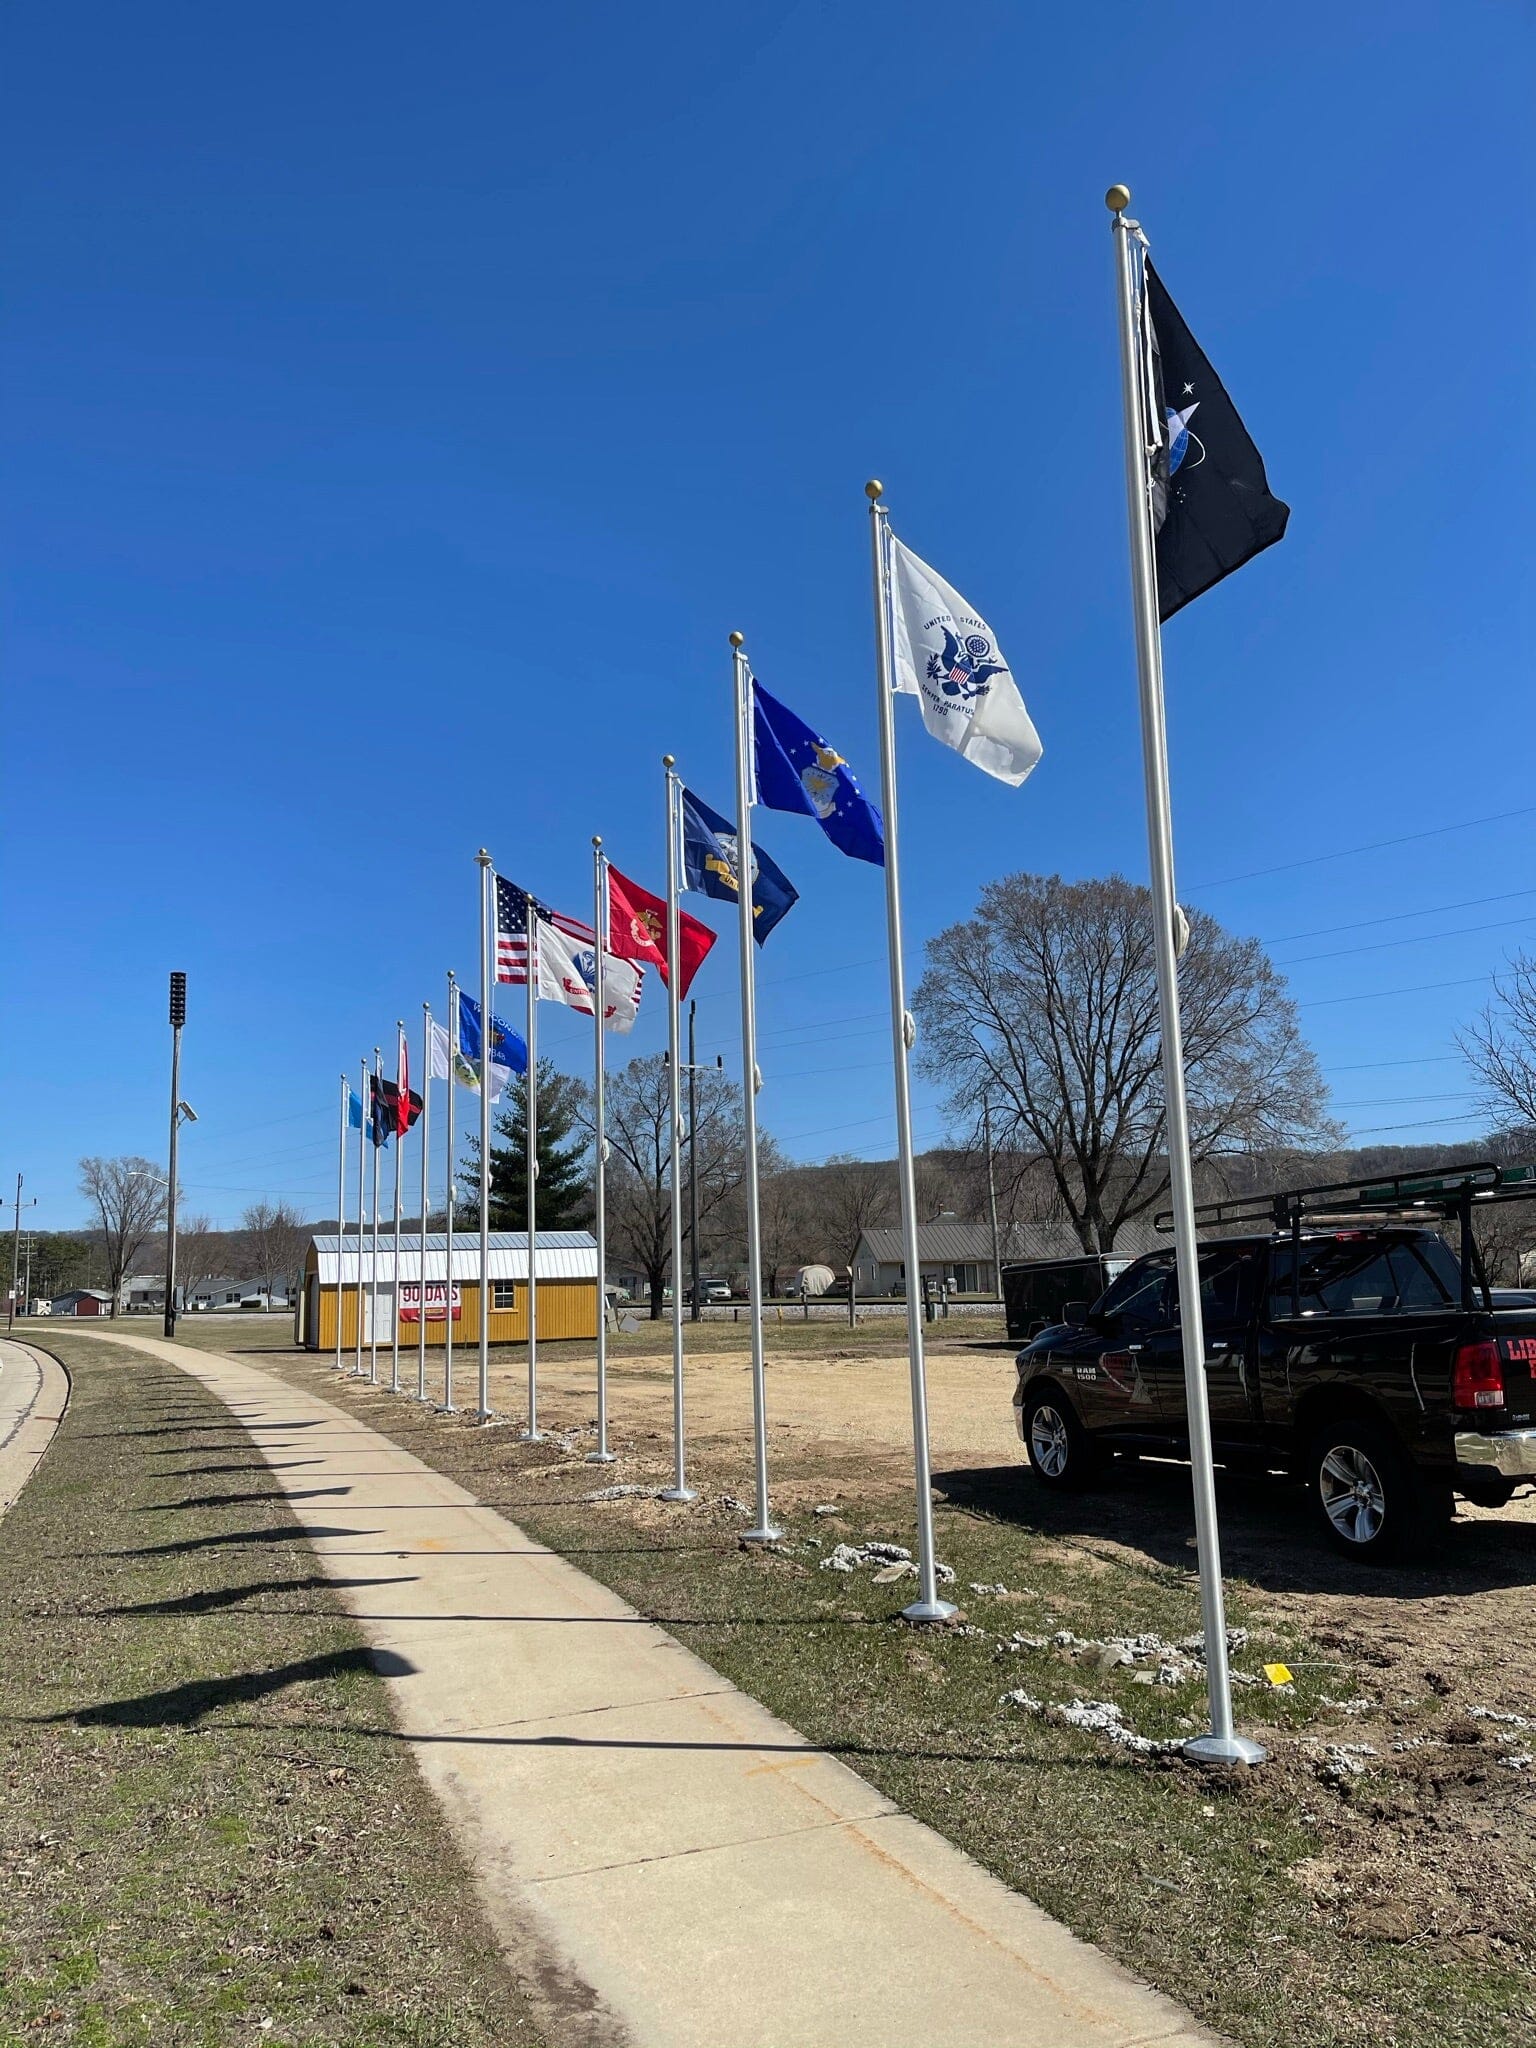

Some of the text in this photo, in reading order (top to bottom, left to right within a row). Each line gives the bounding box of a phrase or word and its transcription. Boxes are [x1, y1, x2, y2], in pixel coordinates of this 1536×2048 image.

[924, 616, 986, 630] UNITED STATES
[922, 684, 974, 715] SEMPER PARATUS
[933, 704, 948, 716] 1790
[403, 1285, 458, 1302] 90 DAYS
